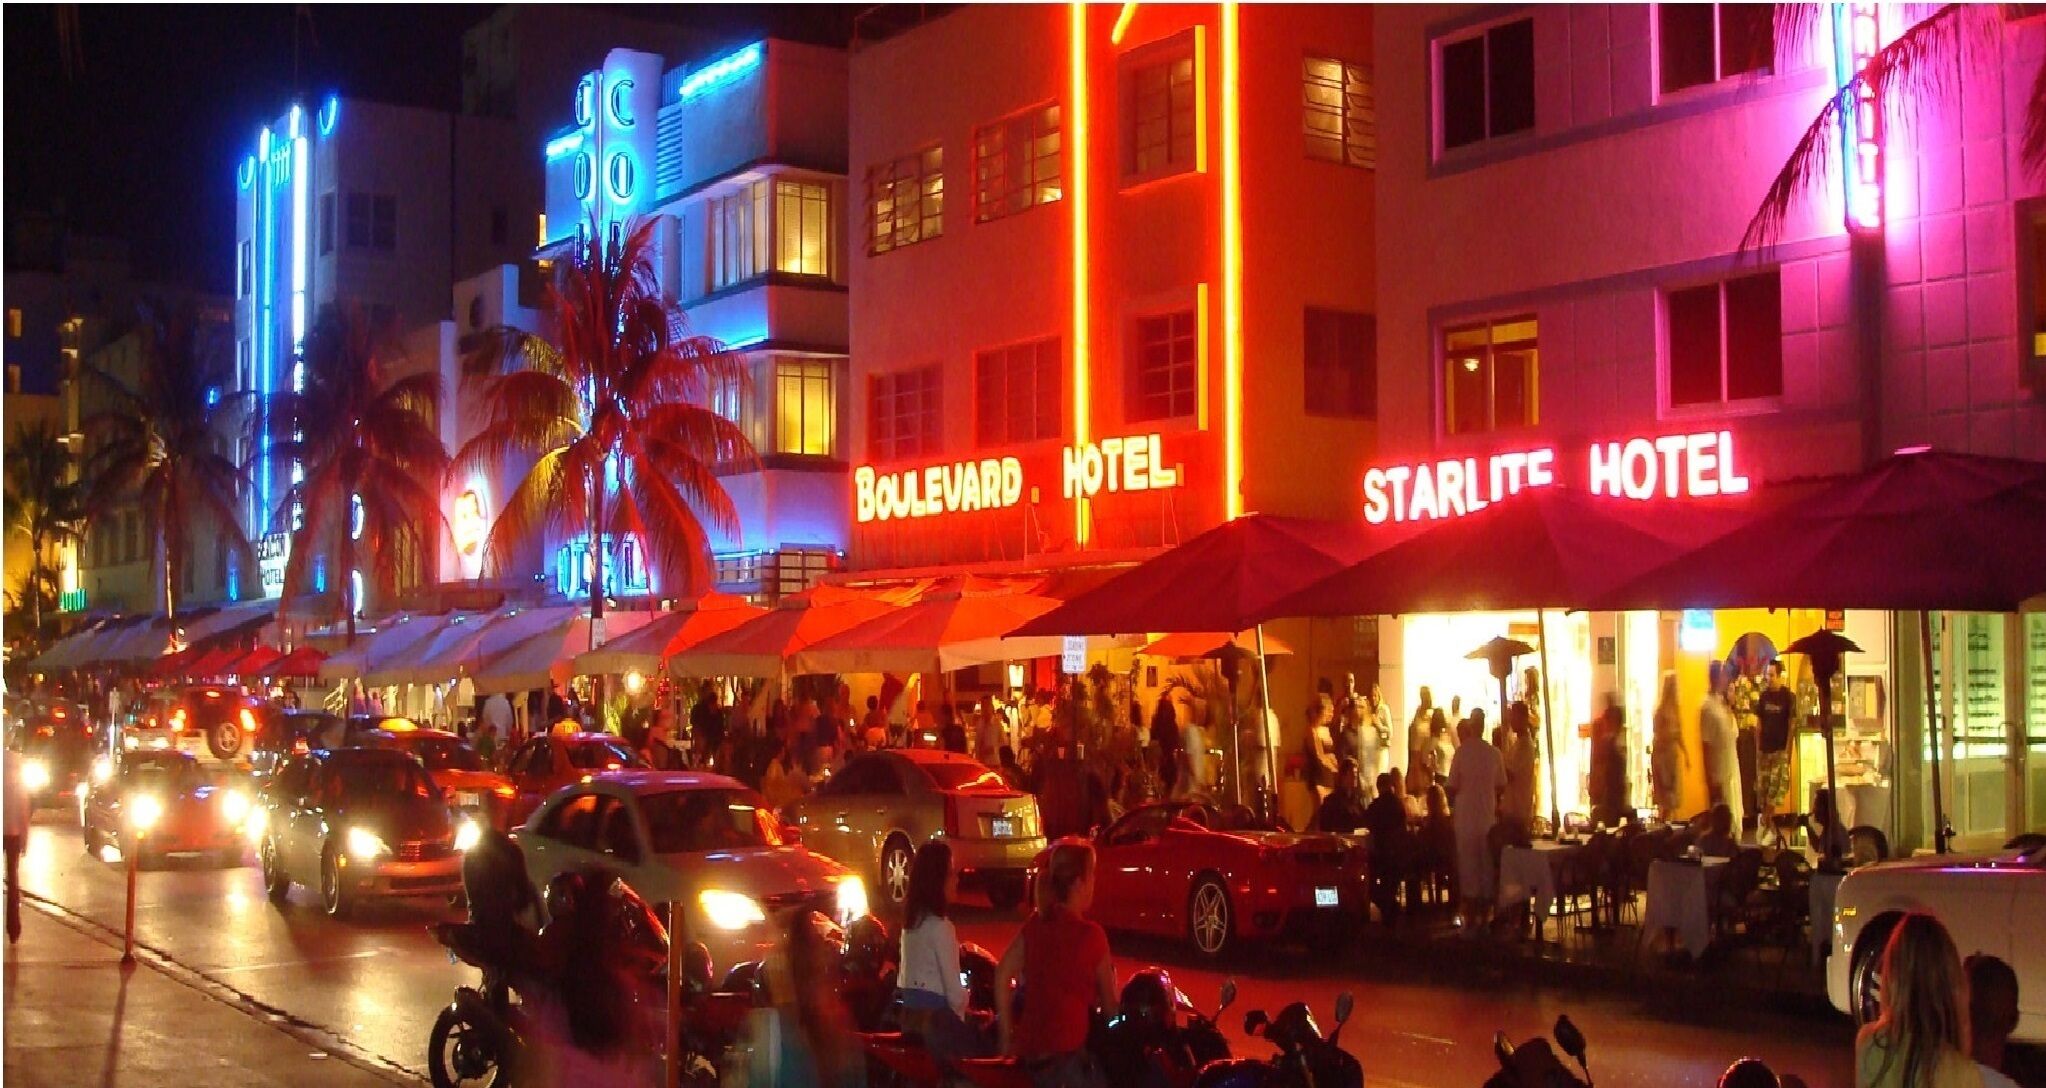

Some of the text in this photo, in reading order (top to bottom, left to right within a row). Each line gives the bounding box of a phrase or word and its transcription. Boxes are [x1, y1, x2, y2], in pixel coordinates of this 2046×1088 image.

[855, 434, 1177, 522] BOULEVARD HOTEL
[1364, 431, 1748, 524] STARLITE HOTEL
